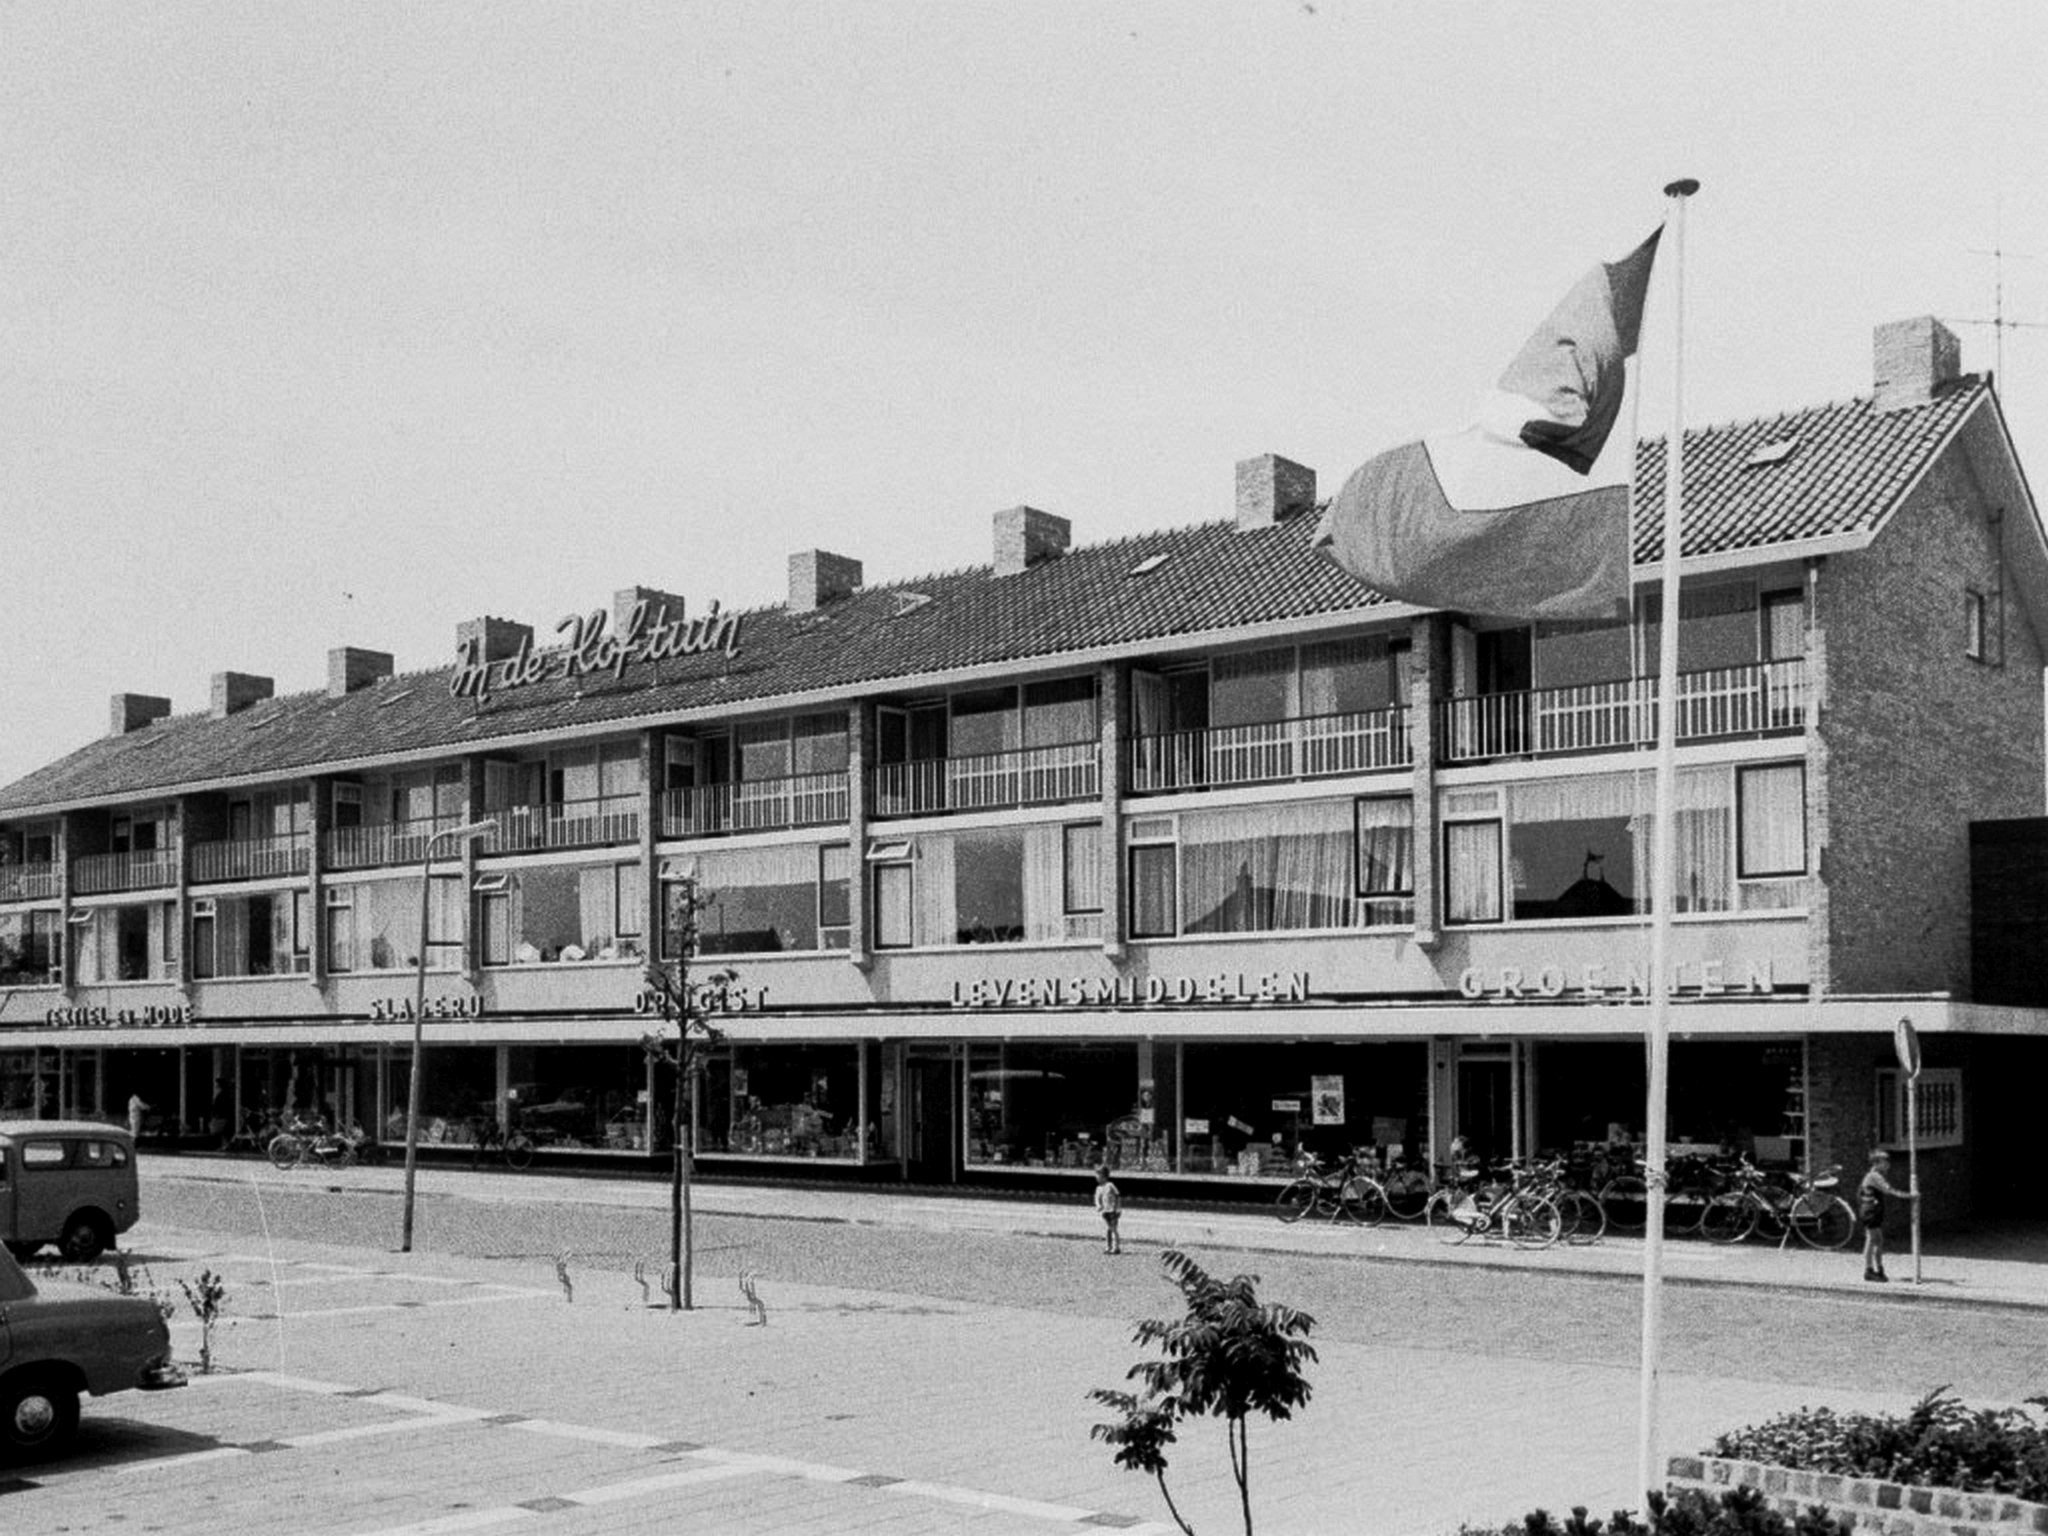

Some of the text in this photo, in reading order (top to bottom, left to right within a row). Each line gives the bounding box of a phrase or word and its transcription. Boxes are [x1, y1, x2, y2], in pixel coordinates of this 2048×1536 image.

[499, 634, 547, 688] de
[557, 599, 743, 679] Hoftuin
[950, 971, 1310, 1007] LEVENSMIDDELEN
[1460, 959, 1774, 1000] GROENTEN
[142, 1003, 195, 1025] MODE
